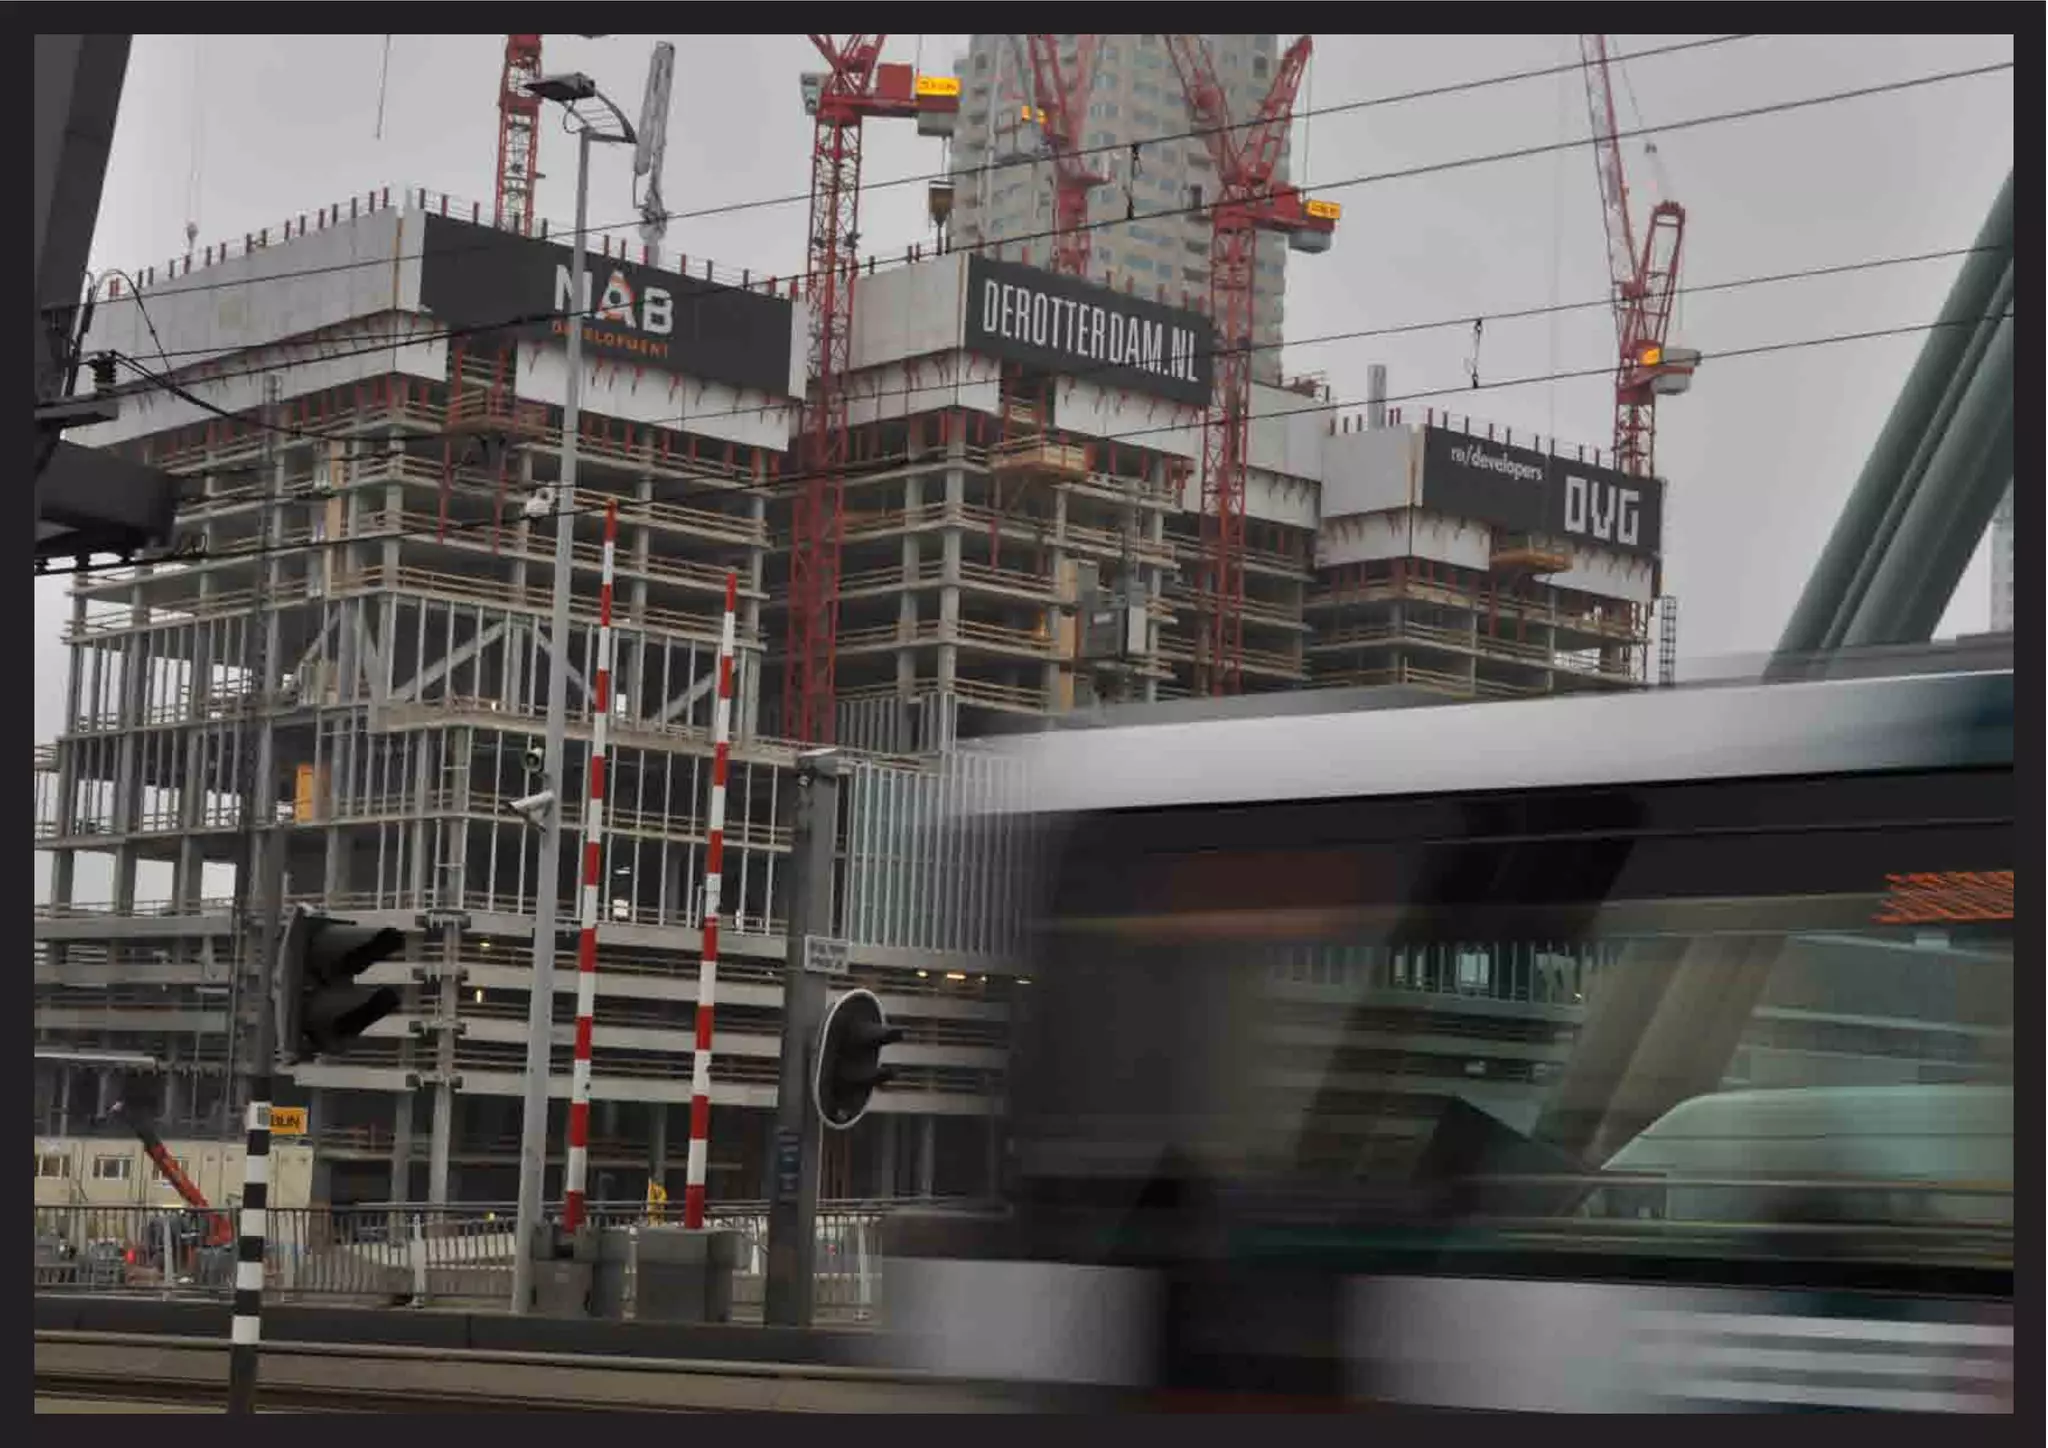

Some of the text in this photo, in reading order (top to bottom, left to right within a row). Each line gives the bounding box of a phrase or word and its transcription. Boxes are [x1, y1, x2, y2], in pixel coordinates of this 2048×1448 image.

[552, 320, 669, 358] DEELOPMENT
[983, 278, 1199, 382] DEROTTERDAM.NL
[1564, 475, 1640, 546] OVG
